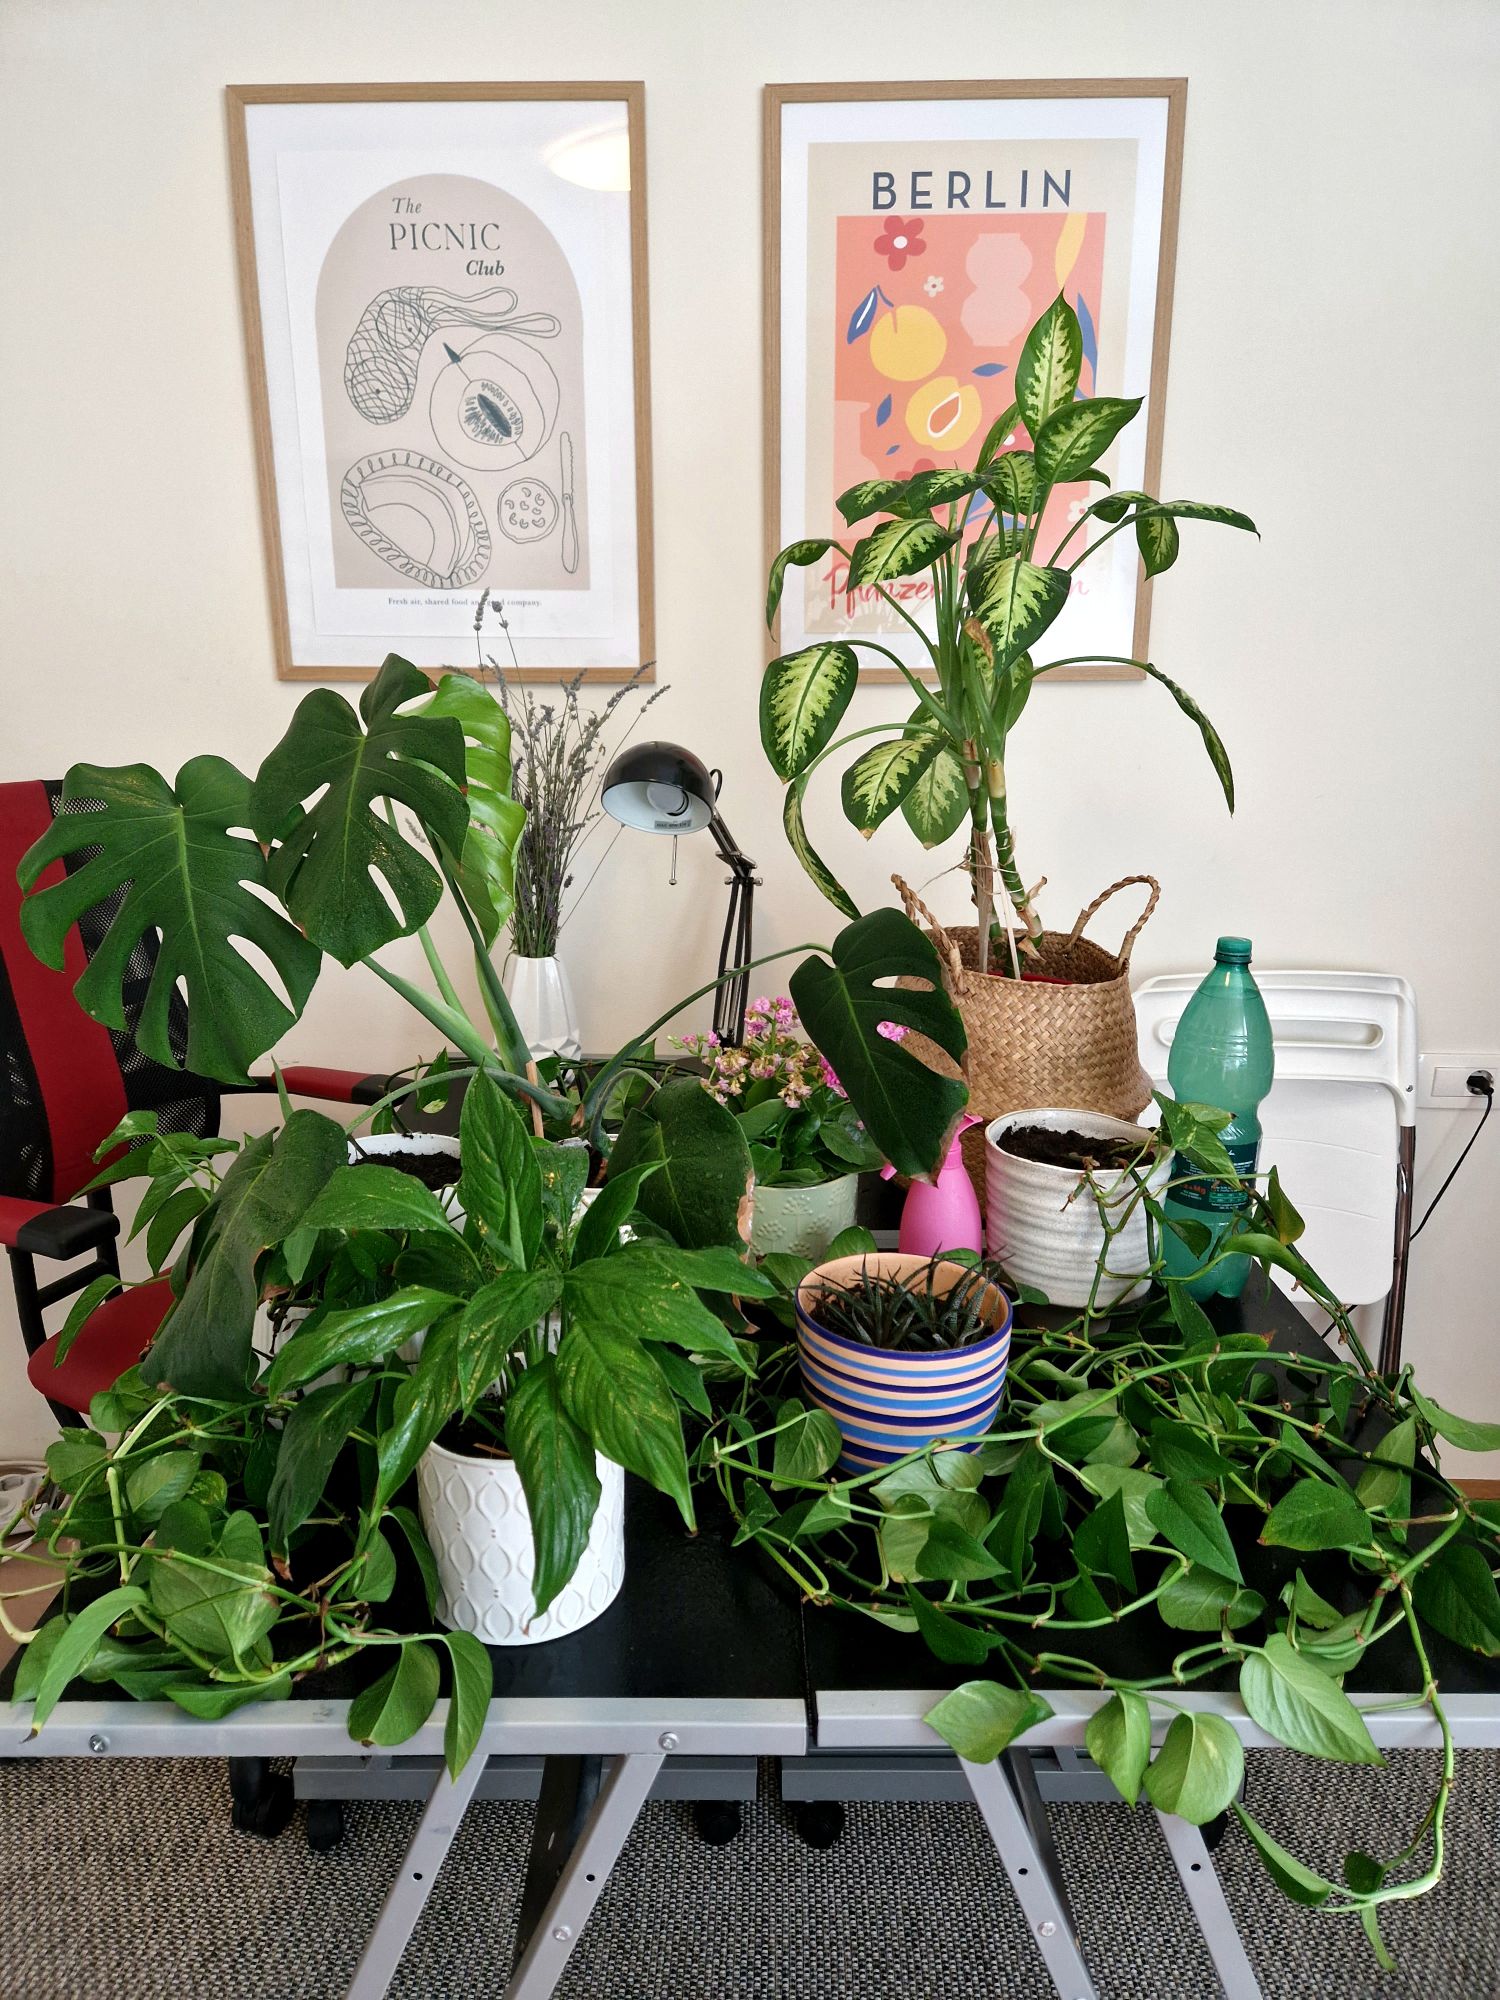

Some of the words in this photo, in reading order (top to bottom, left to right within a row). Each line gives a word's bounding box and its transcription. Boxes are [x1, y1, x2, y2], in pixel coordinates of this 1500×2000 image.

[872, 169, 1071, 210] BERLIN
[392, 197, 422, 214] The
[389, 222, 501, 251] PICNIC
[465, 259, 505, 276] Club
[388, 597, 408, 605] Fresh
[425, 597, 449, 605] shared
[451, 597, 468, 606] food
